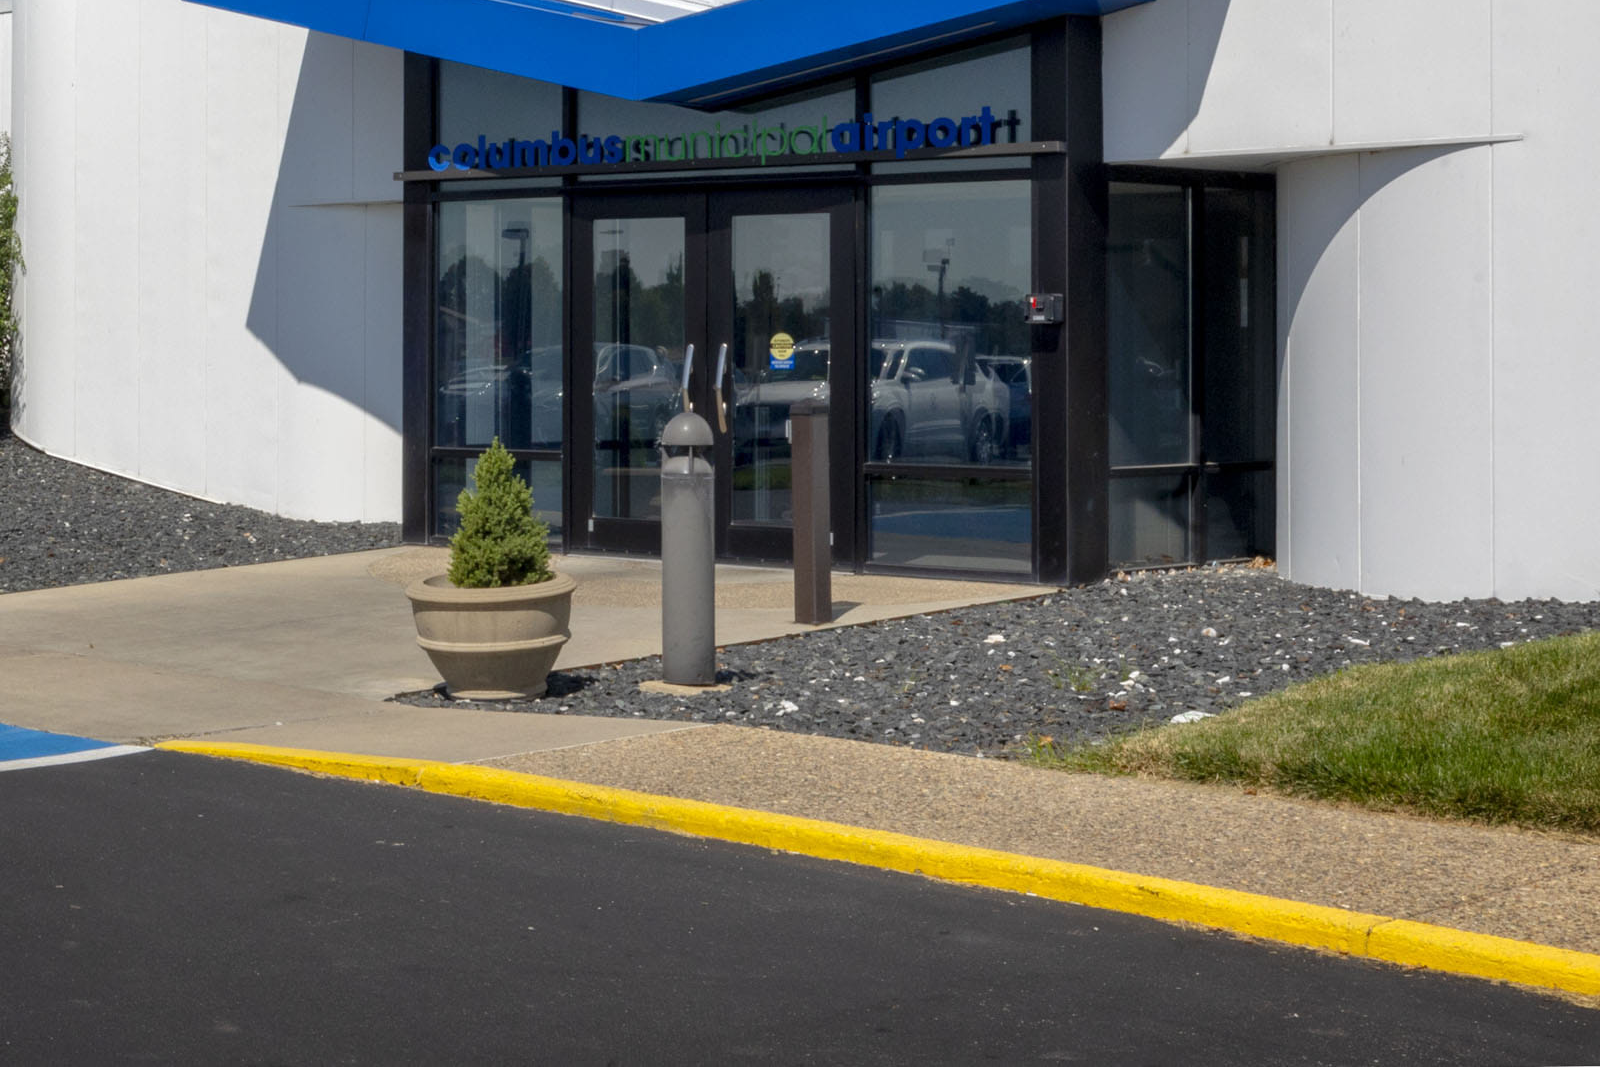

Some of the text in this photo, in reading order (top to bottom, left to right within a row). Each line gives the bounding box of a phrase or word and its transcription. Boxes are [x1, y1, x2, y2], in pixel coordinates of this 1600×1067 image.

[428, 106, 996, 173] columbus municipal airport
